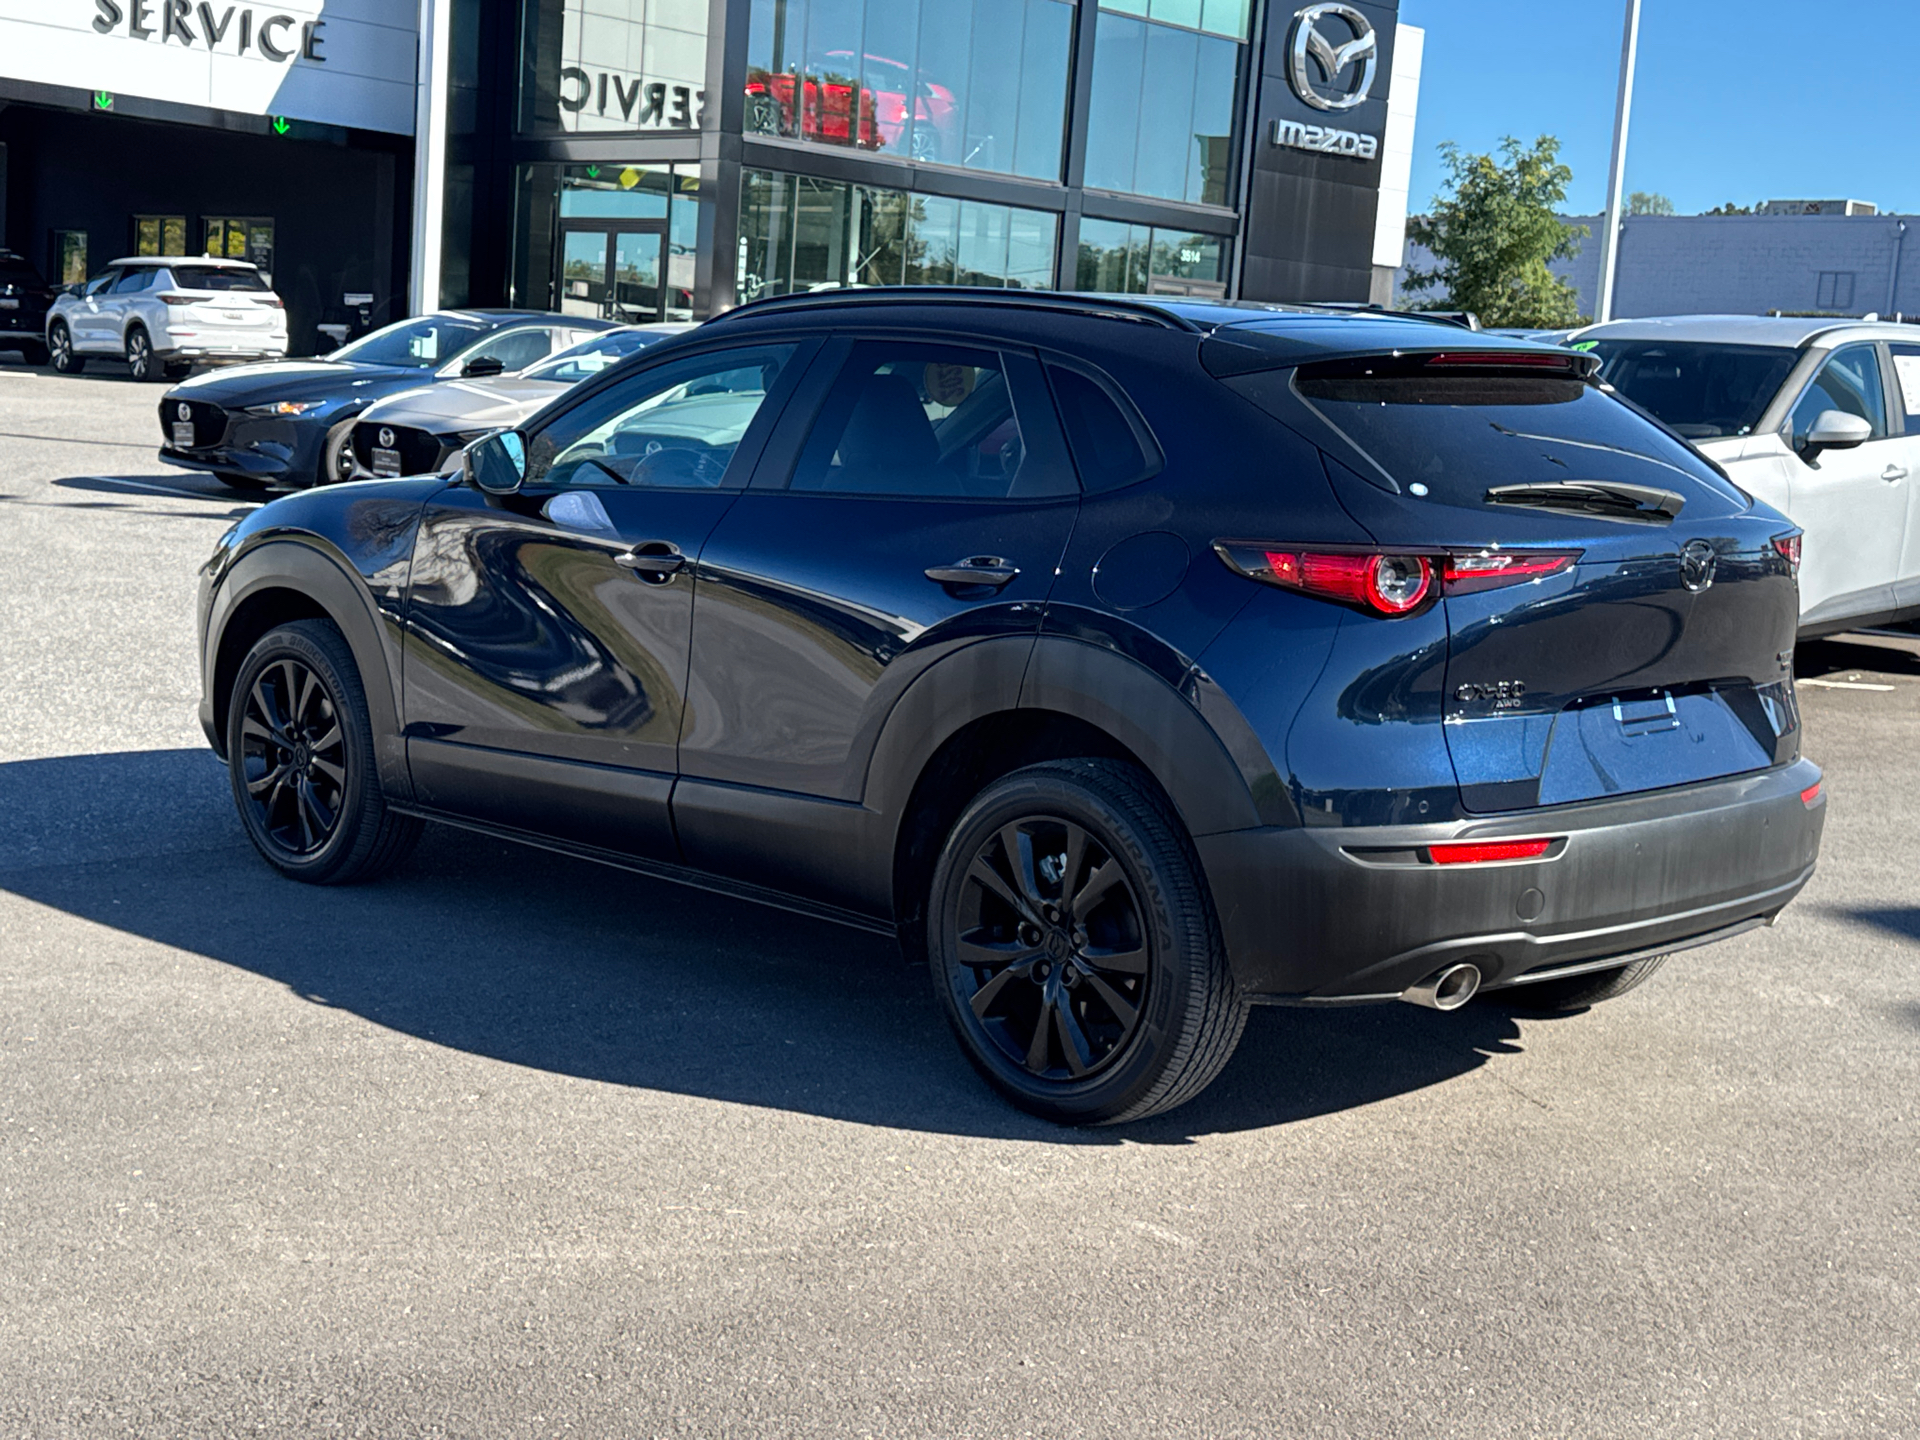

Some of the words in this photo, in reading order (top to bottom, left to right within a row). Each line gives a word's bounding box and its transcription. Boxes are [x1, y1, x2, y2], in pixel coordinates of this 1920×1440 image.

[92, 0, 326, 63] SERVICE
[1181, 249, 1200, 263] 3514
[1103, 810, 1171, 950] TURANZA
